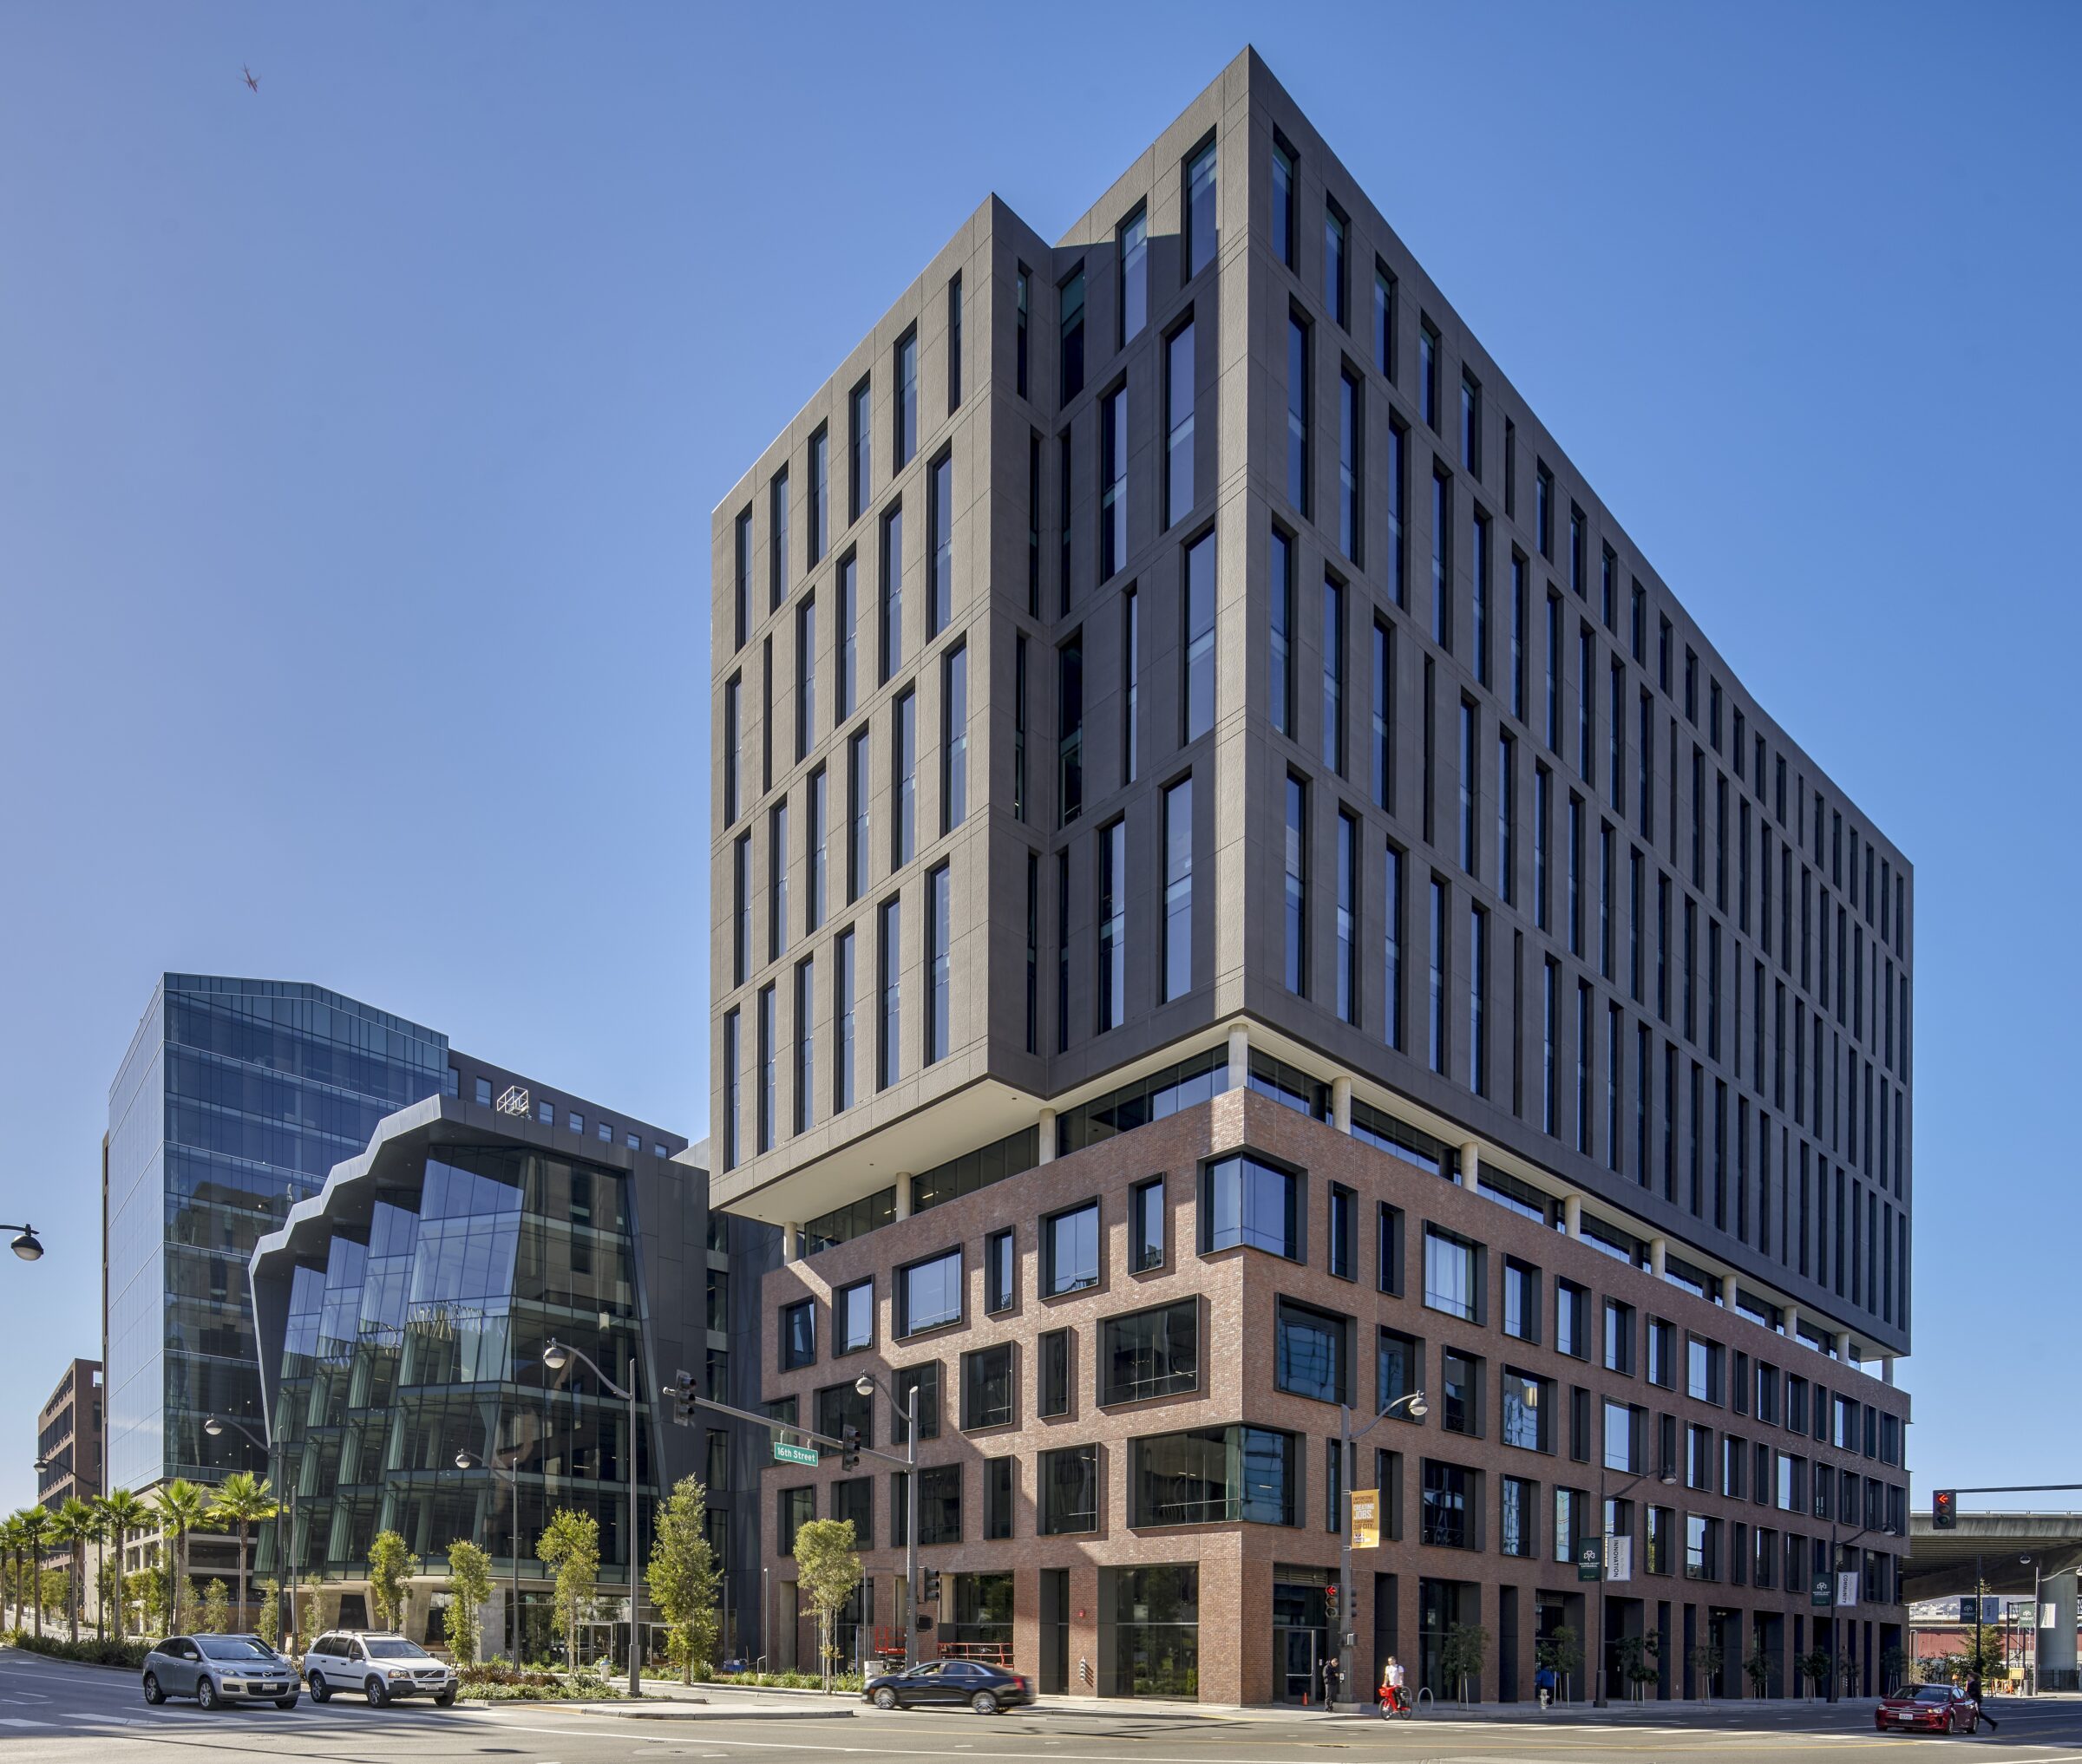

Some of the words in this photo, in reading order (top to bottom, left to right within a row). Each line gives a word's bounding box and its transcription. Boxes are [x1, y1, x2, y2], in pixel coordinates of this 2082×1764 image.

[777, 1447, 792, 1458] 16th
[793, 1449, 815, 1462] Street
[1353, 1510, 1374, 1519] JOBS.
